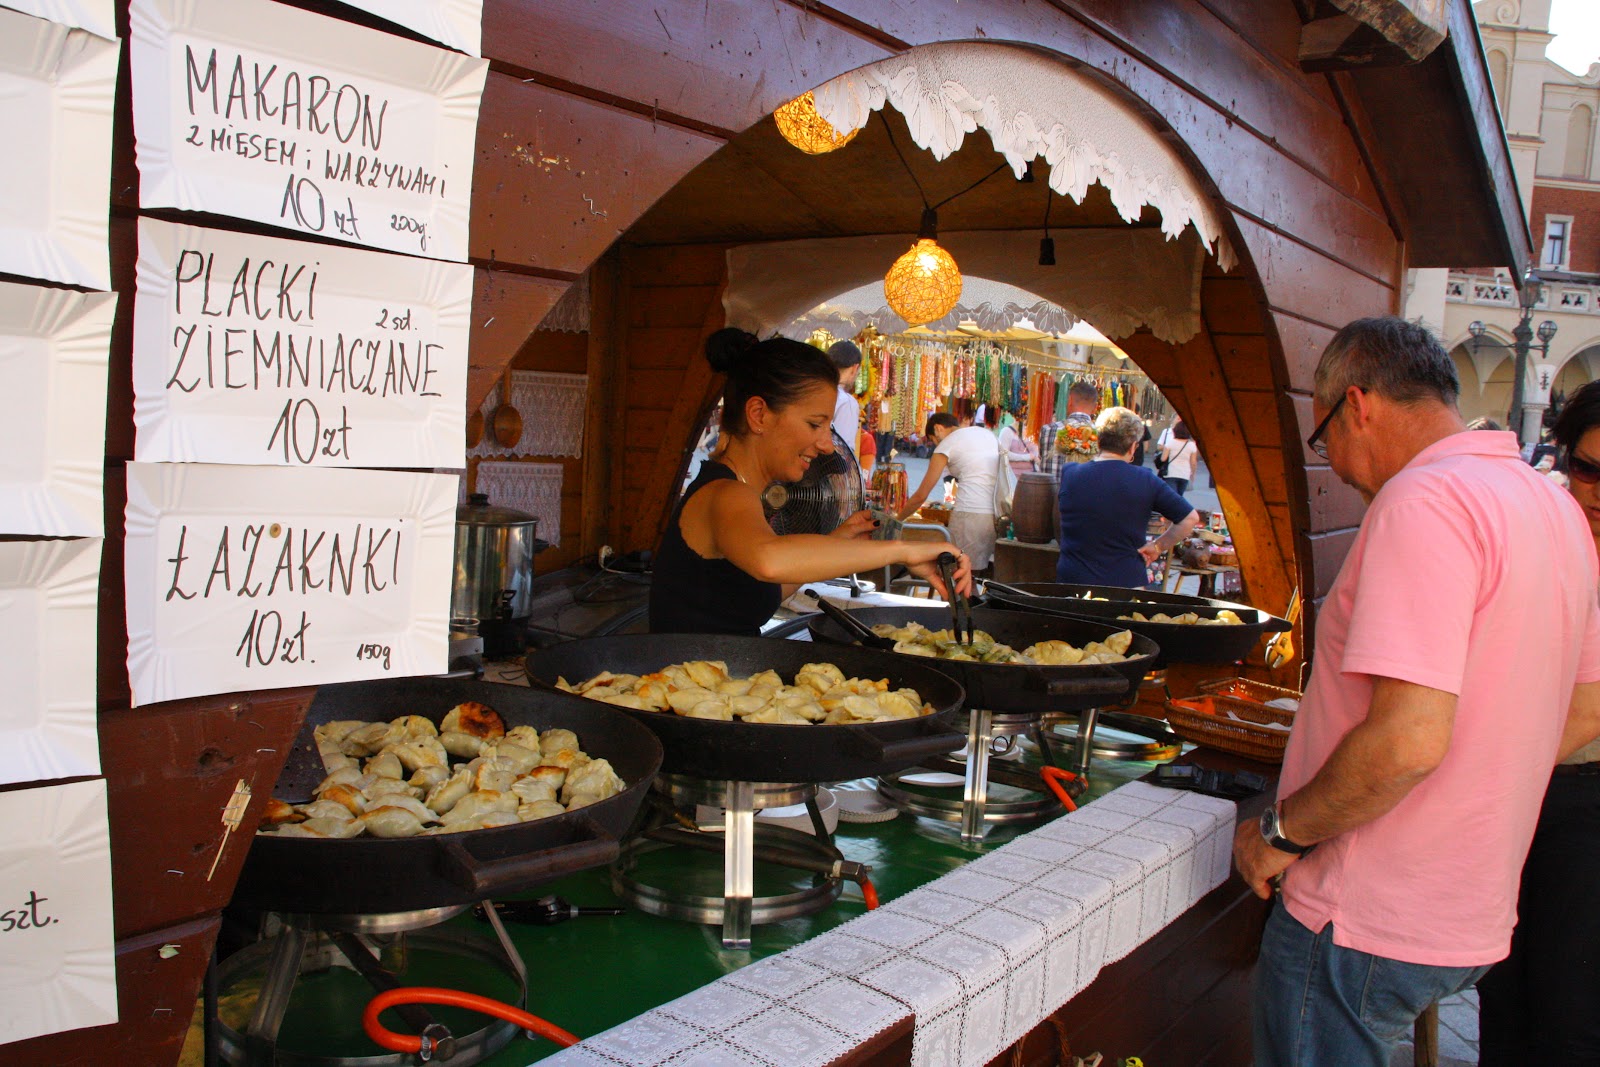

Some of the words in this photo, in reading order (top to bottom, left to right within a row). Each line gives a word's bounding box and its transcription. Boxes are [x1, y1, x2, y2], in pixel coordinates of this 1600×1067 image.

[185, 44, 388, 151] MAKARON
[280, 173, 326, 232] 10
[375, 308, 389, 329] 2
[356, 643, 392, 670] 150g
